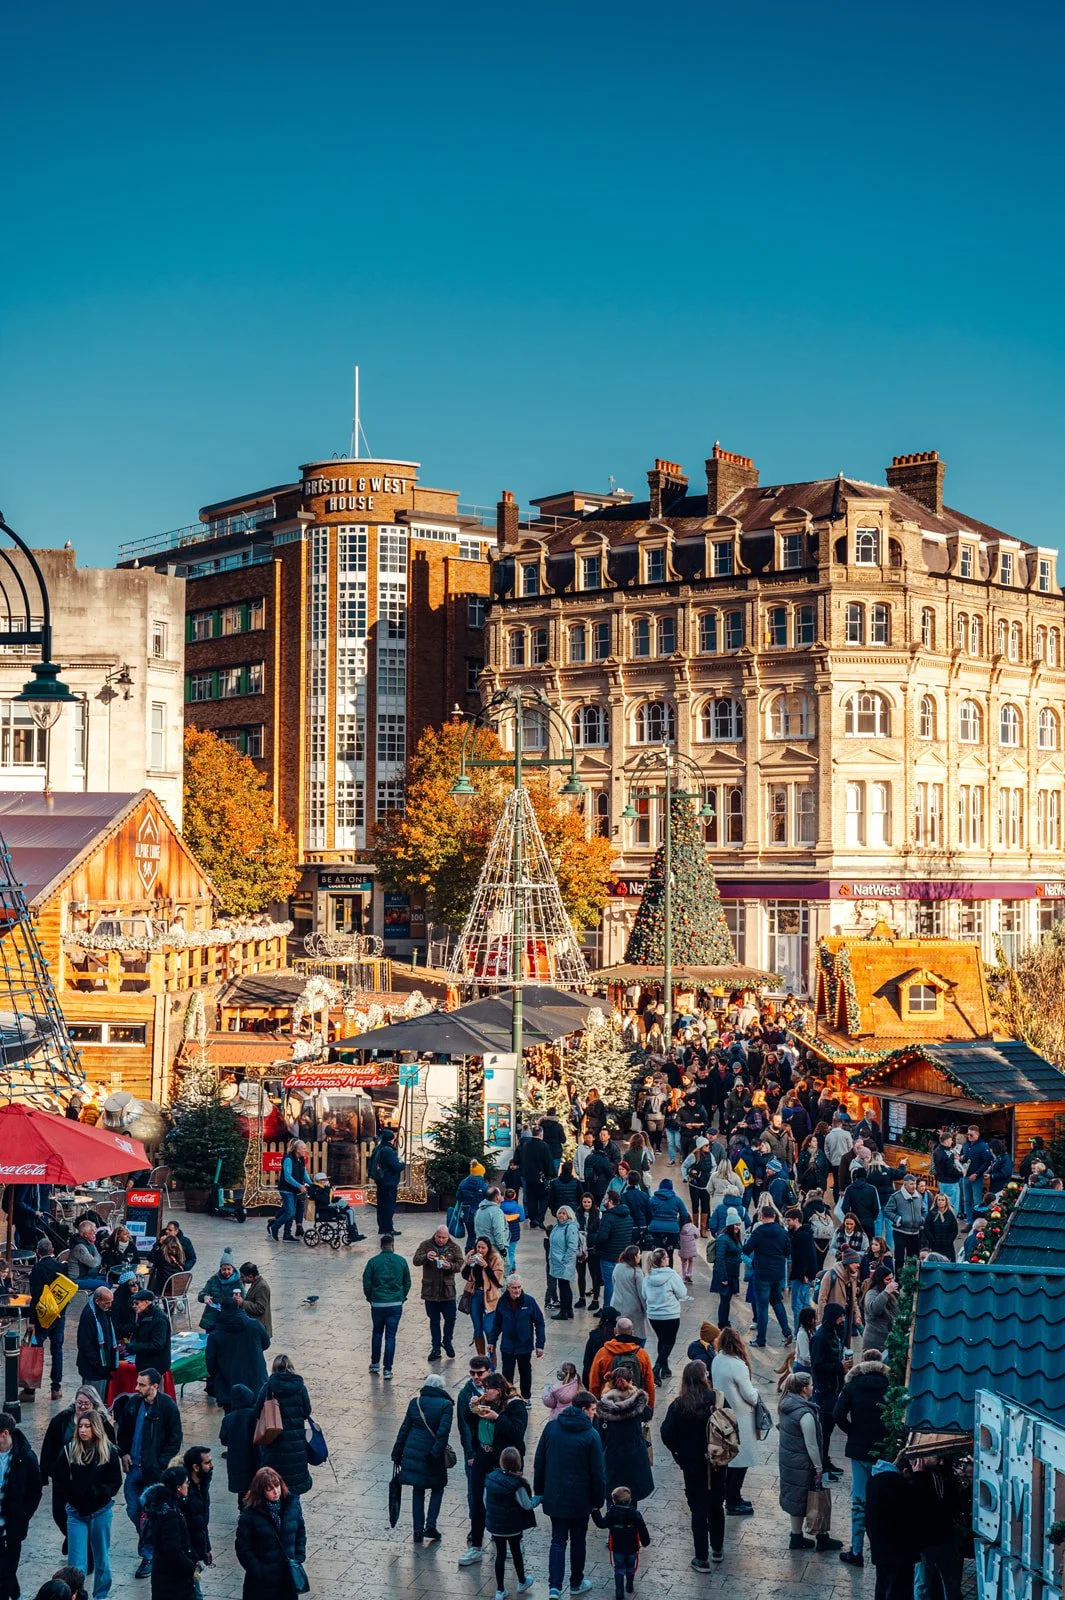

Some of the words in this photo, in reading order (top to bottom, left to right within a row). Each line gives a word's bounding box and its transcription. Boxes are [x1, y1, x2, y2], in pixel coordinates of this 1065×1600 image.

[305, 478, 352, 495] BRISTOL
[359, 477, 366, 491] &
[371, 478, 407, 493] WEST
[329, 496, 374, 511] HOUSE
[335, 876, 345, 884] AT
[853, 884, 901, 896] NatWest
[299, 1065, 376, 1075] Bournemouth
[284, 1076, 341, 1087] Christmas
[344, 1075, 389, 1087] Market
